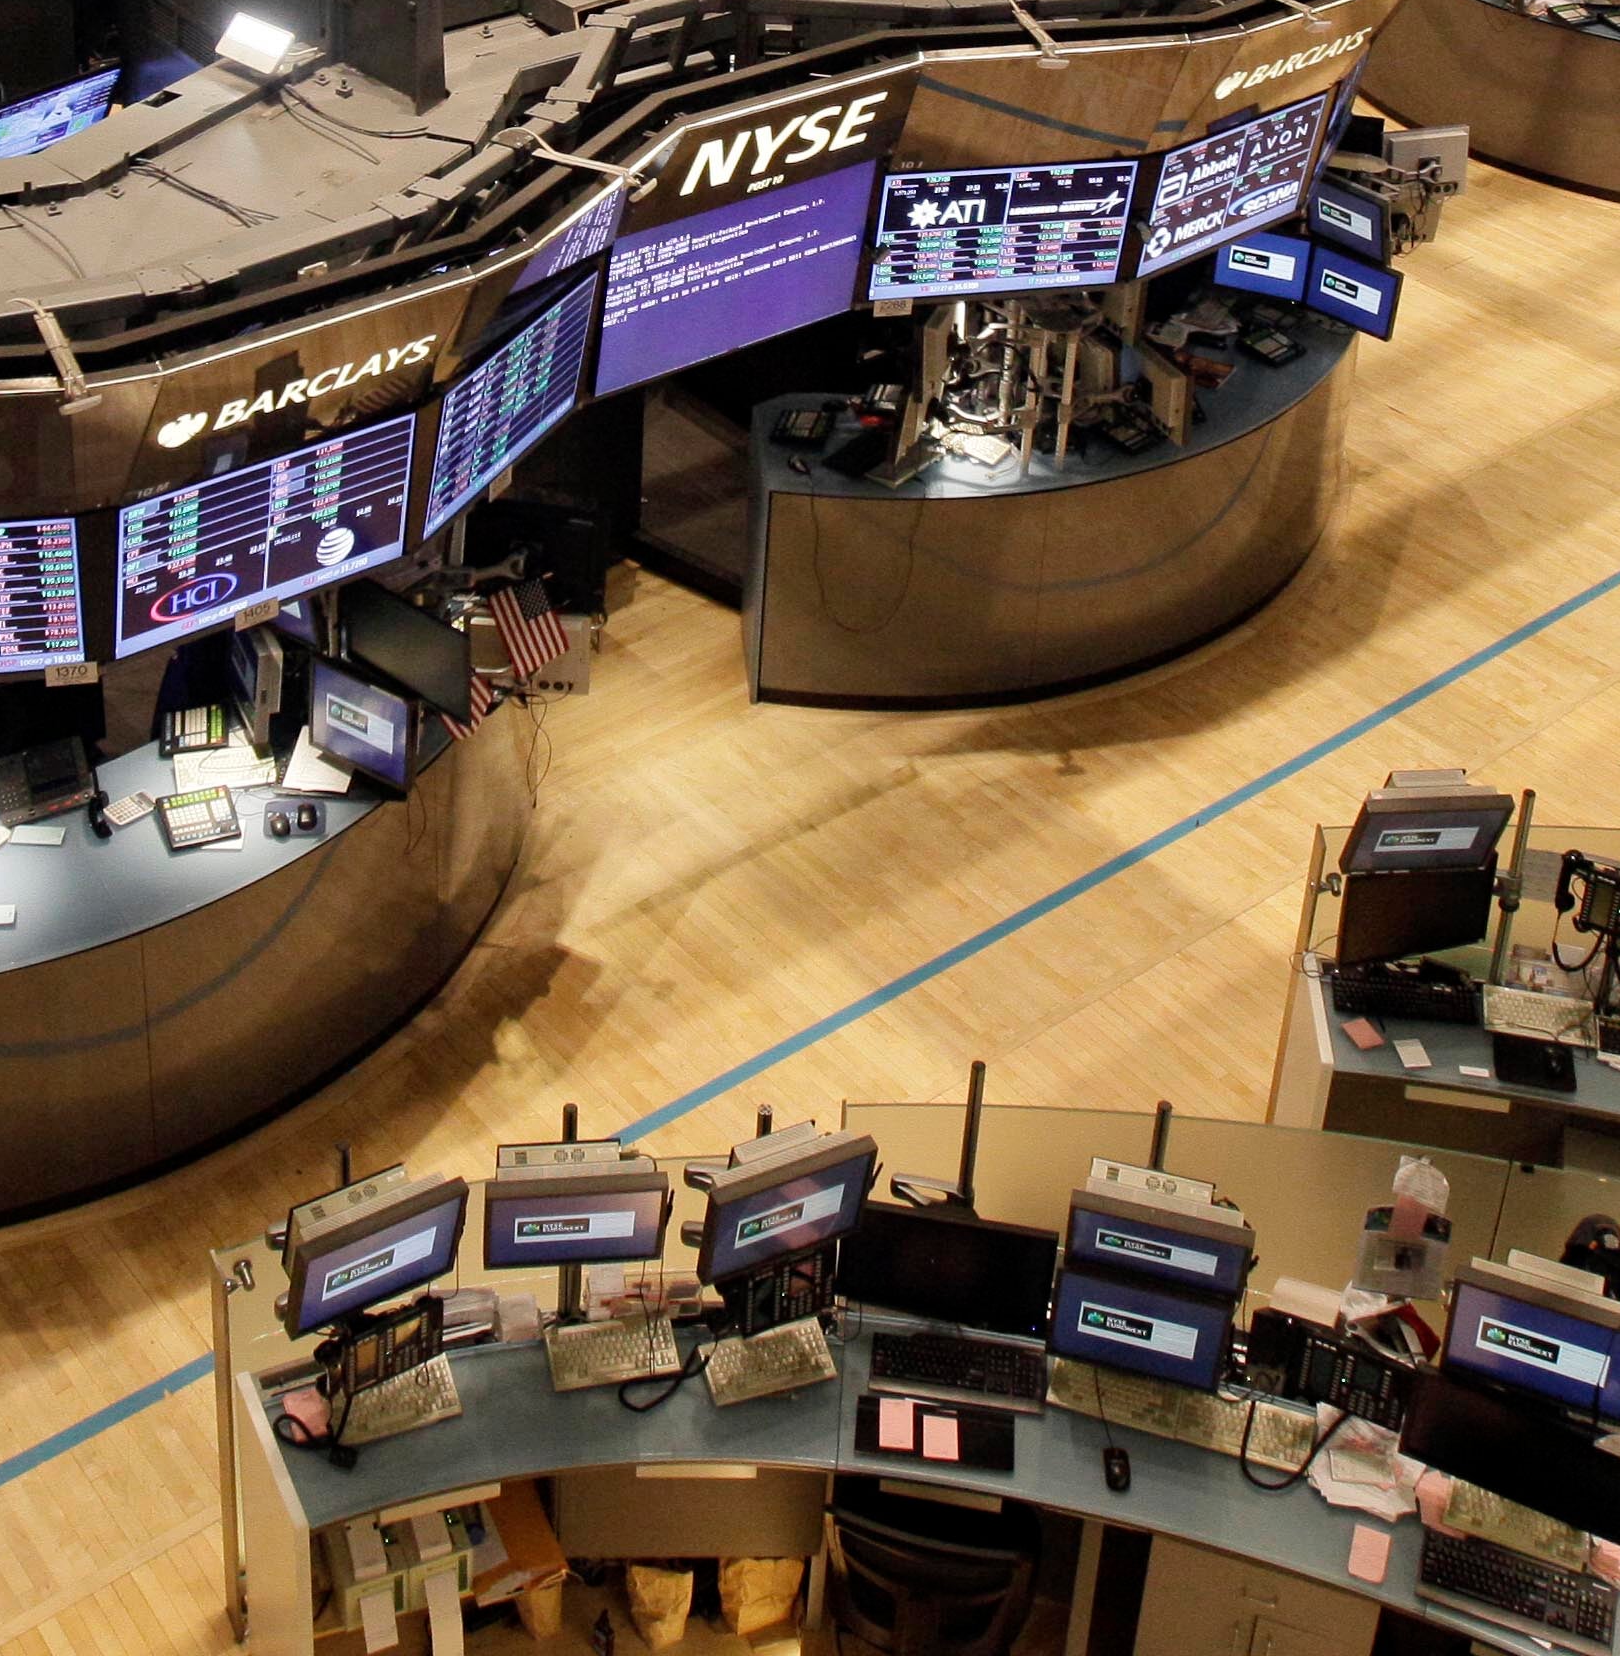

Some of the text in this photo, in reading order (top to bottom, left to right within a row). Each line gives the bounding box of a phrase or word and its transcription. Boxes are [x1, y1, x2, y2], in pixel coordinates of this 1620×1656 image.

[1243, 26, 1372, 90] BARCLAYS
[679, 91, 889, 196] NYSE
[1250, 122, 1310, 157] AVON
[1188, 151, 1239, 185] Abbott
[938, 199, 986, 225] ATI
[1173, 209, 1225, 244] MERCK
[211, 333, 438, 433] BARCLAYS
[170, 580, 218, 615] HCI
[55, 664, 87, 678] 1370
[1507, 1340, 1554, 1359] EURONEXT
